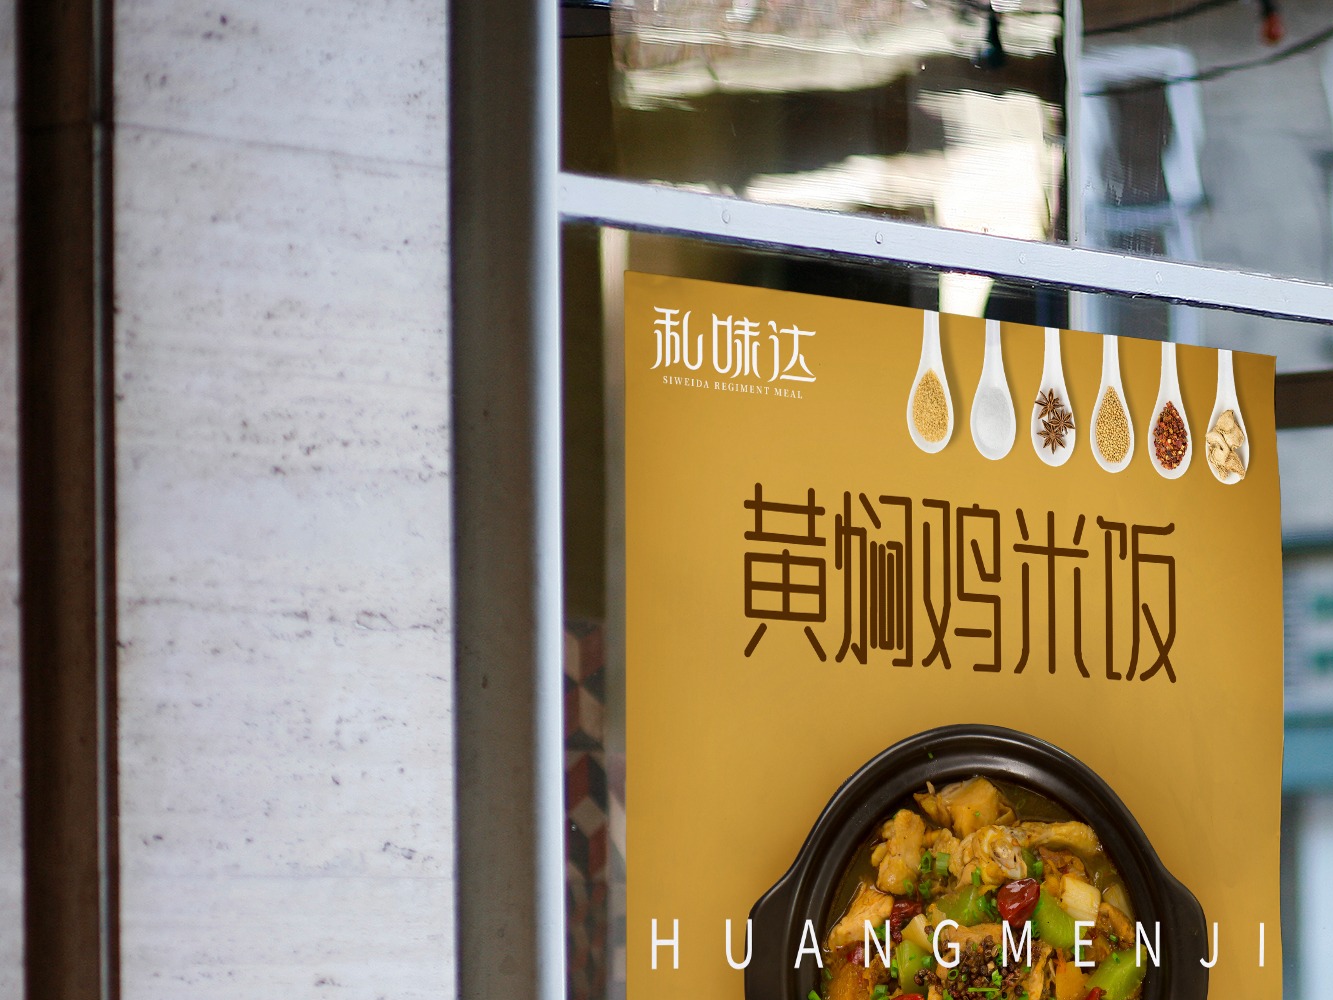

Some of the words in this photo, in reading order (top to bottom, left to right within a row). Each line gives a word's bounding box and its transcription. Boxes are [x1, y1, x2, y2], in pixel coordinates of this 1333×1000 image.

[650, 305, 817, 383] 私味达
[662, 375, 710, 389] SIWEIDA
[714, 381, 770, 395] REGIMENT
[774, 387, 803, 399] MEAL
[743, 482, 1178, 684] 黄焖鸡米饭
[650, 918, 1266, 970] HUANGMENJI
